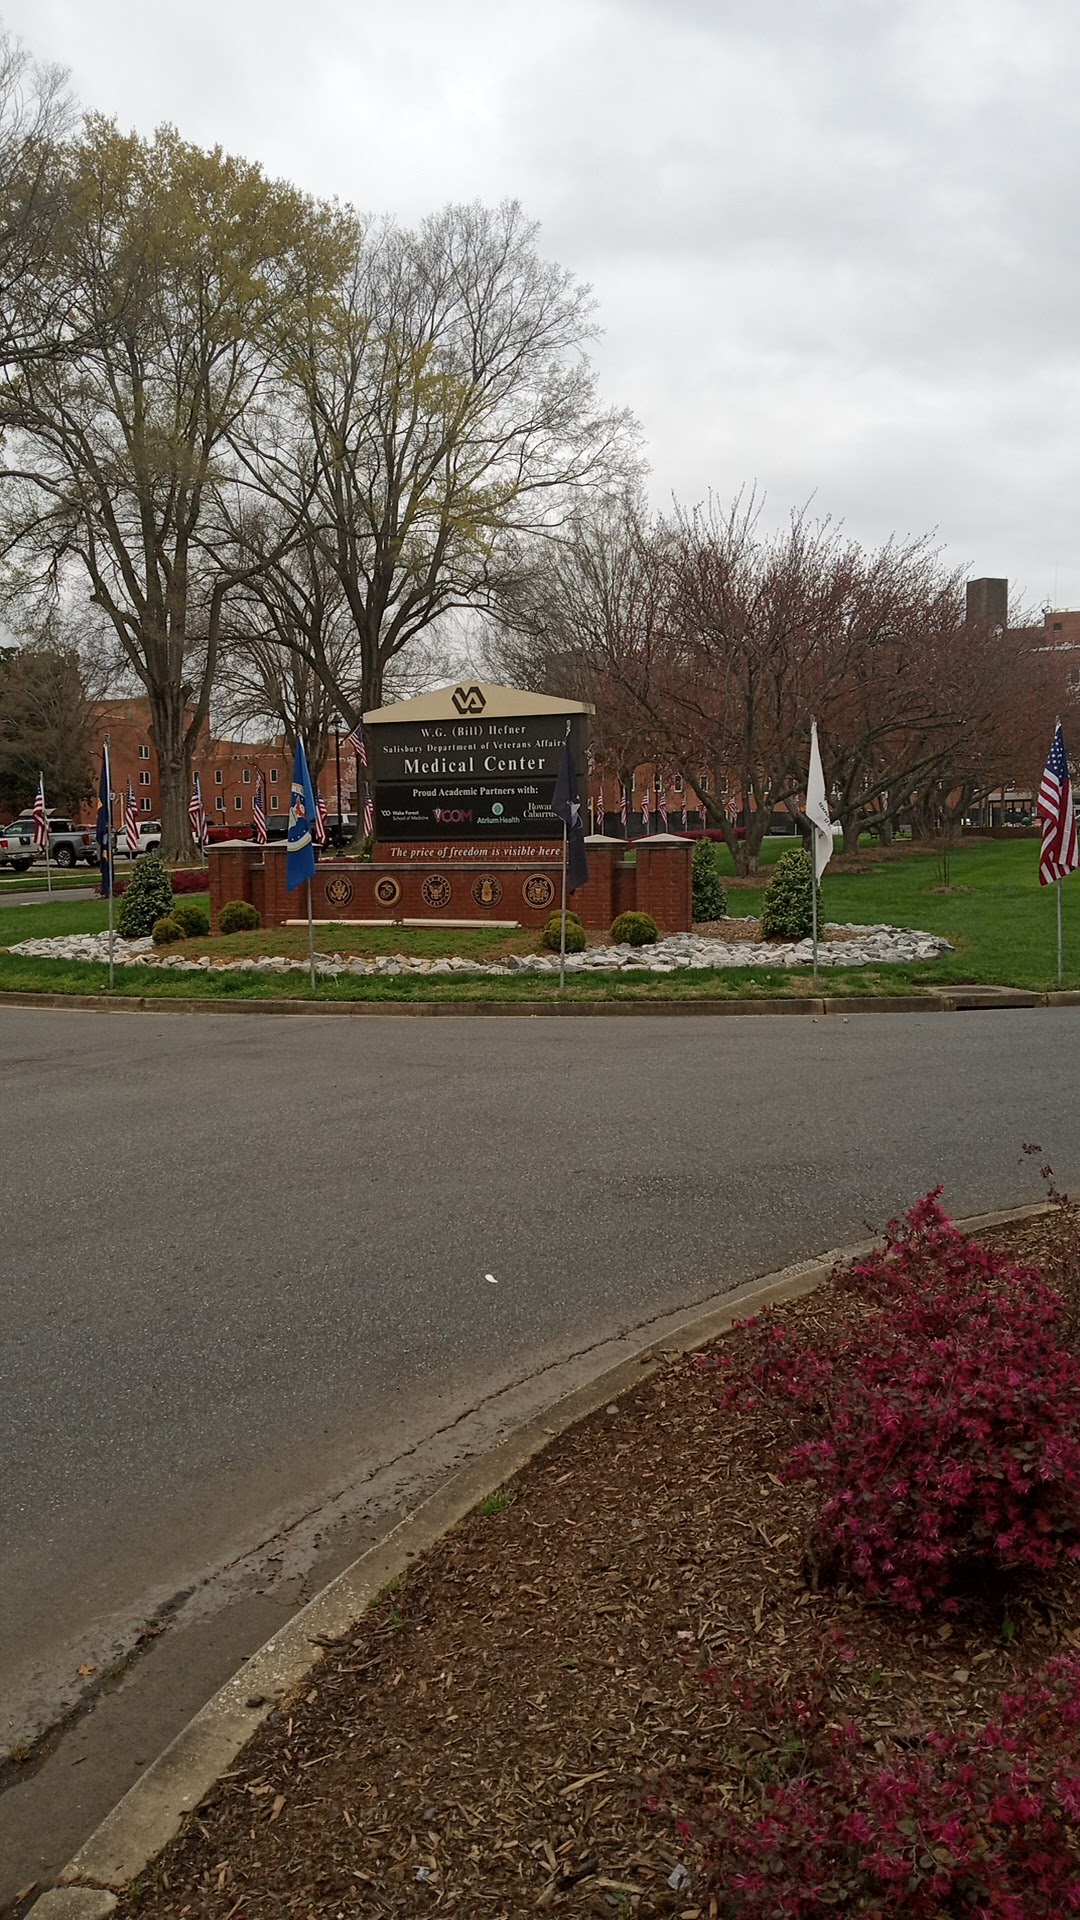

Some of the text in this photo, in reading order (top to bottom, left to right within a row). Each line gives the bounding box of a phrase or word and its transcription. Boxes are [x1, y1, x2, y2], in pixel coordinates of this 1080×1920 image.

[421, 725, 526, 738] W.G. (Bill) Hefner
[383, 739, 567, 754] Salisbury Department of Veterans Affairs
[404, 755, 546, 774] Medical Center
[412, 785, 539, 797] Proud Academic Partners with:
[476, 816, 500, 824] Atrium
[500, 815, 520, 824] Health
[390, 846, 561, 859] The price of freedom is visible here
